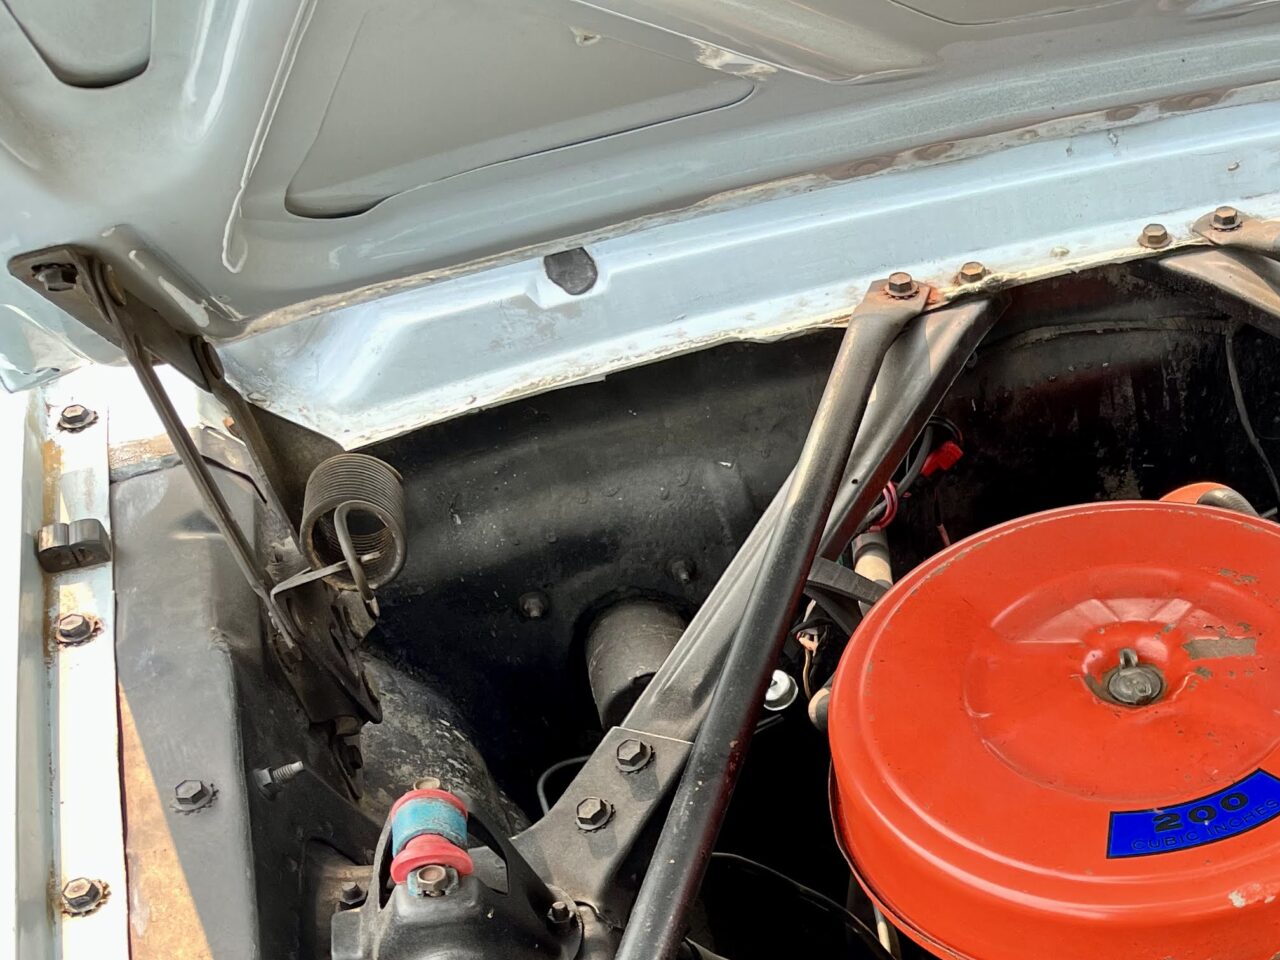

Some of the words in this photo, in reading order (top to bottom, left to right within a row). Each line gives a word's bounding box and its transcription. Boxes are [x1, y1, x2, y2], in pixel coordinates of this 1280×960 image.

[1131, 831, 1199, 850] CUBIC
[1207, 799, 1279, 833] INCHES
[1152, 792, 1249, 833] 200
